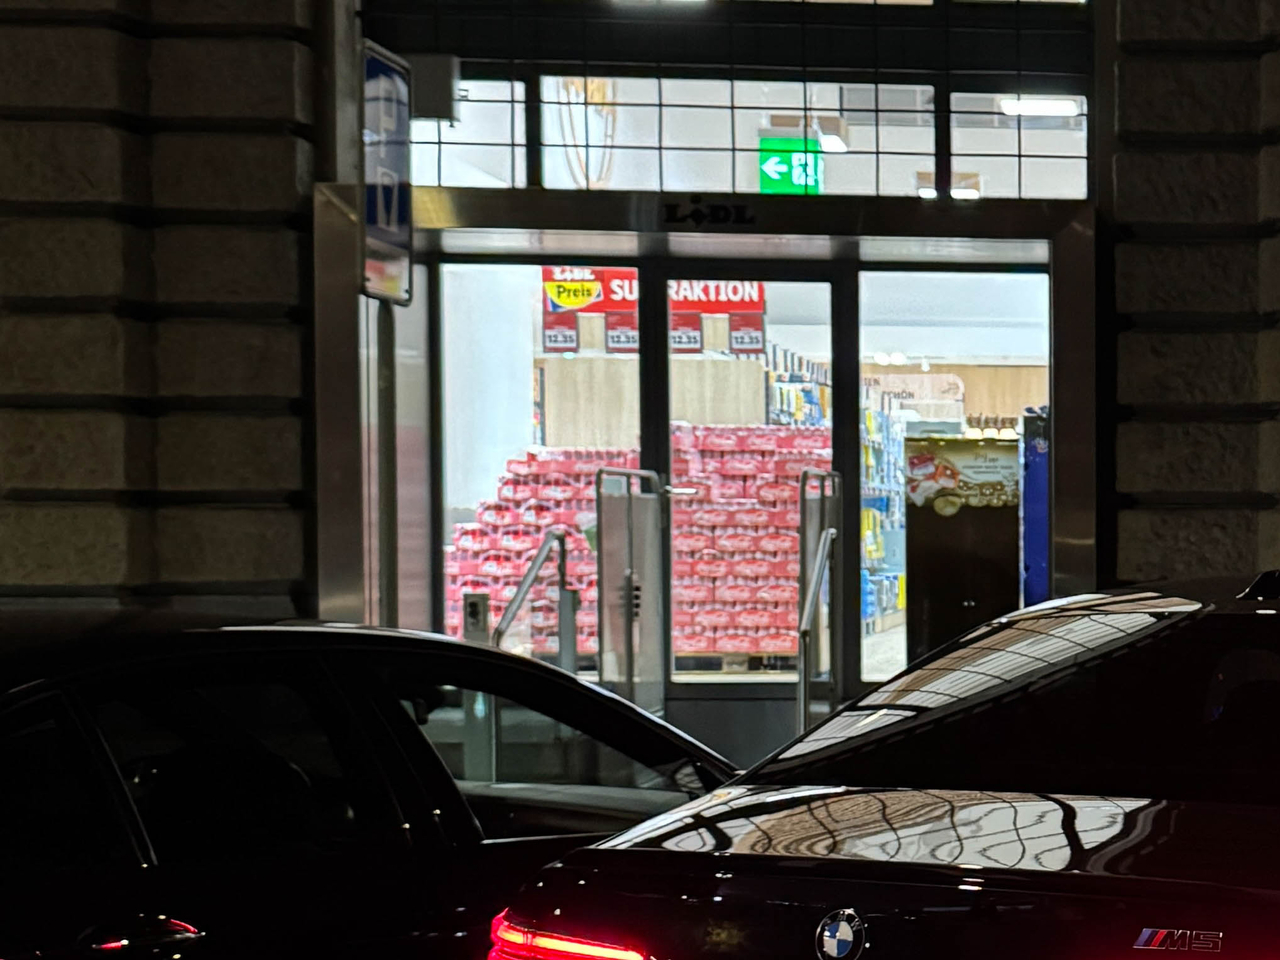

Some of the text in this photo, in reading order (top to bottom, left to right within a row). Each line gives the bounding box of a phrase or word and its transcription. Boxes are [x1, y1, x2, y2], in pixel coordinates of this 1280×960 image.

[664, 193, 756, 227] LIDL
[556, 283, 592, 299] Preis
[609, 278, 760, 303] SURAKTION
